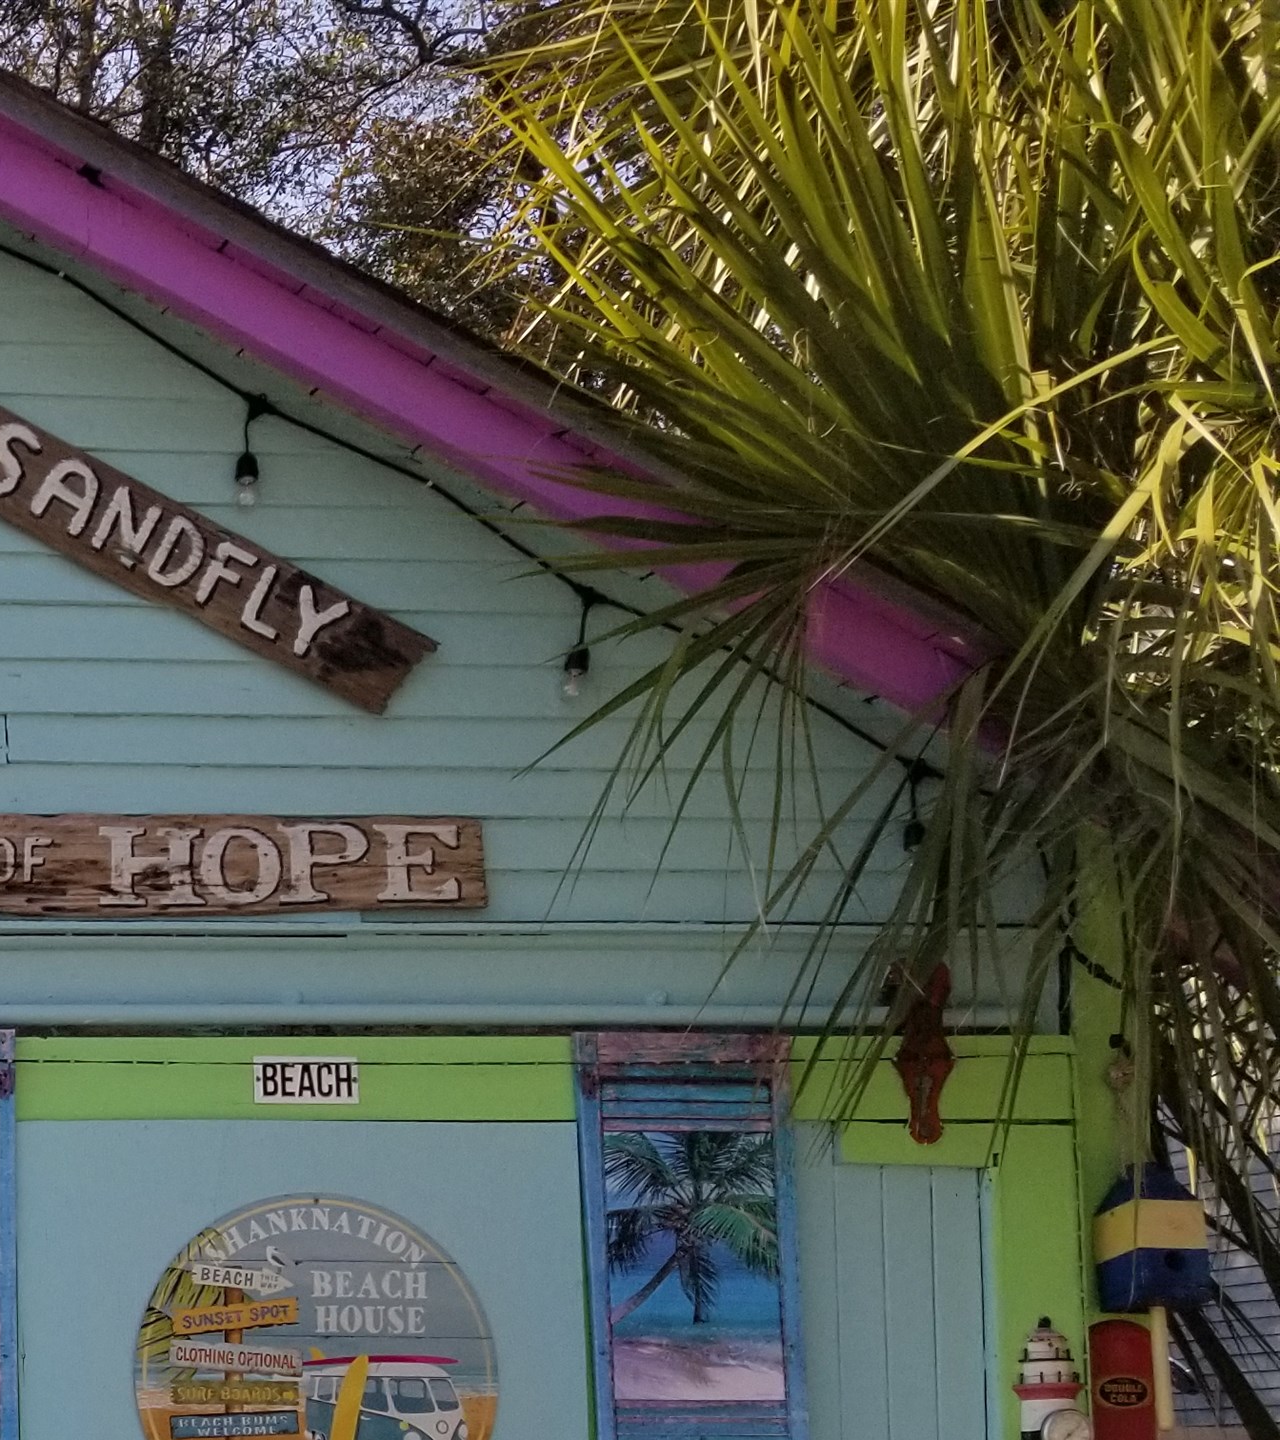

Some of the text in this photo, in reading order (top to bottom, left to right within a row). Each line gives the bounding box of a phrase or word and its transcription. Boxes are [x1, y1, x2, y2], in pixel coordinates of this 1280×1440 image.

[96, 822, 462, 905] HOPE
[261, 1062, 353, 1097] BEACH
[204, 1207, 428, 1270] SHANKNATION
[201, 1267, 254, 1287] BEACH
[310, 1270, 428, 1299] BEACH
[182, 1304, 290, 1329] SUNSET SPOT
[314, 1305, 427, 1334] HOUSE
[175, 1347, 297, 1369] CLOTHING OPTIONAL
[177, 1387, 281, 1402] SURF BOARDS
[178, 1415, 289, 1428] BEACH BUMS
[197, 1426, 278, 1437] WELCOME
